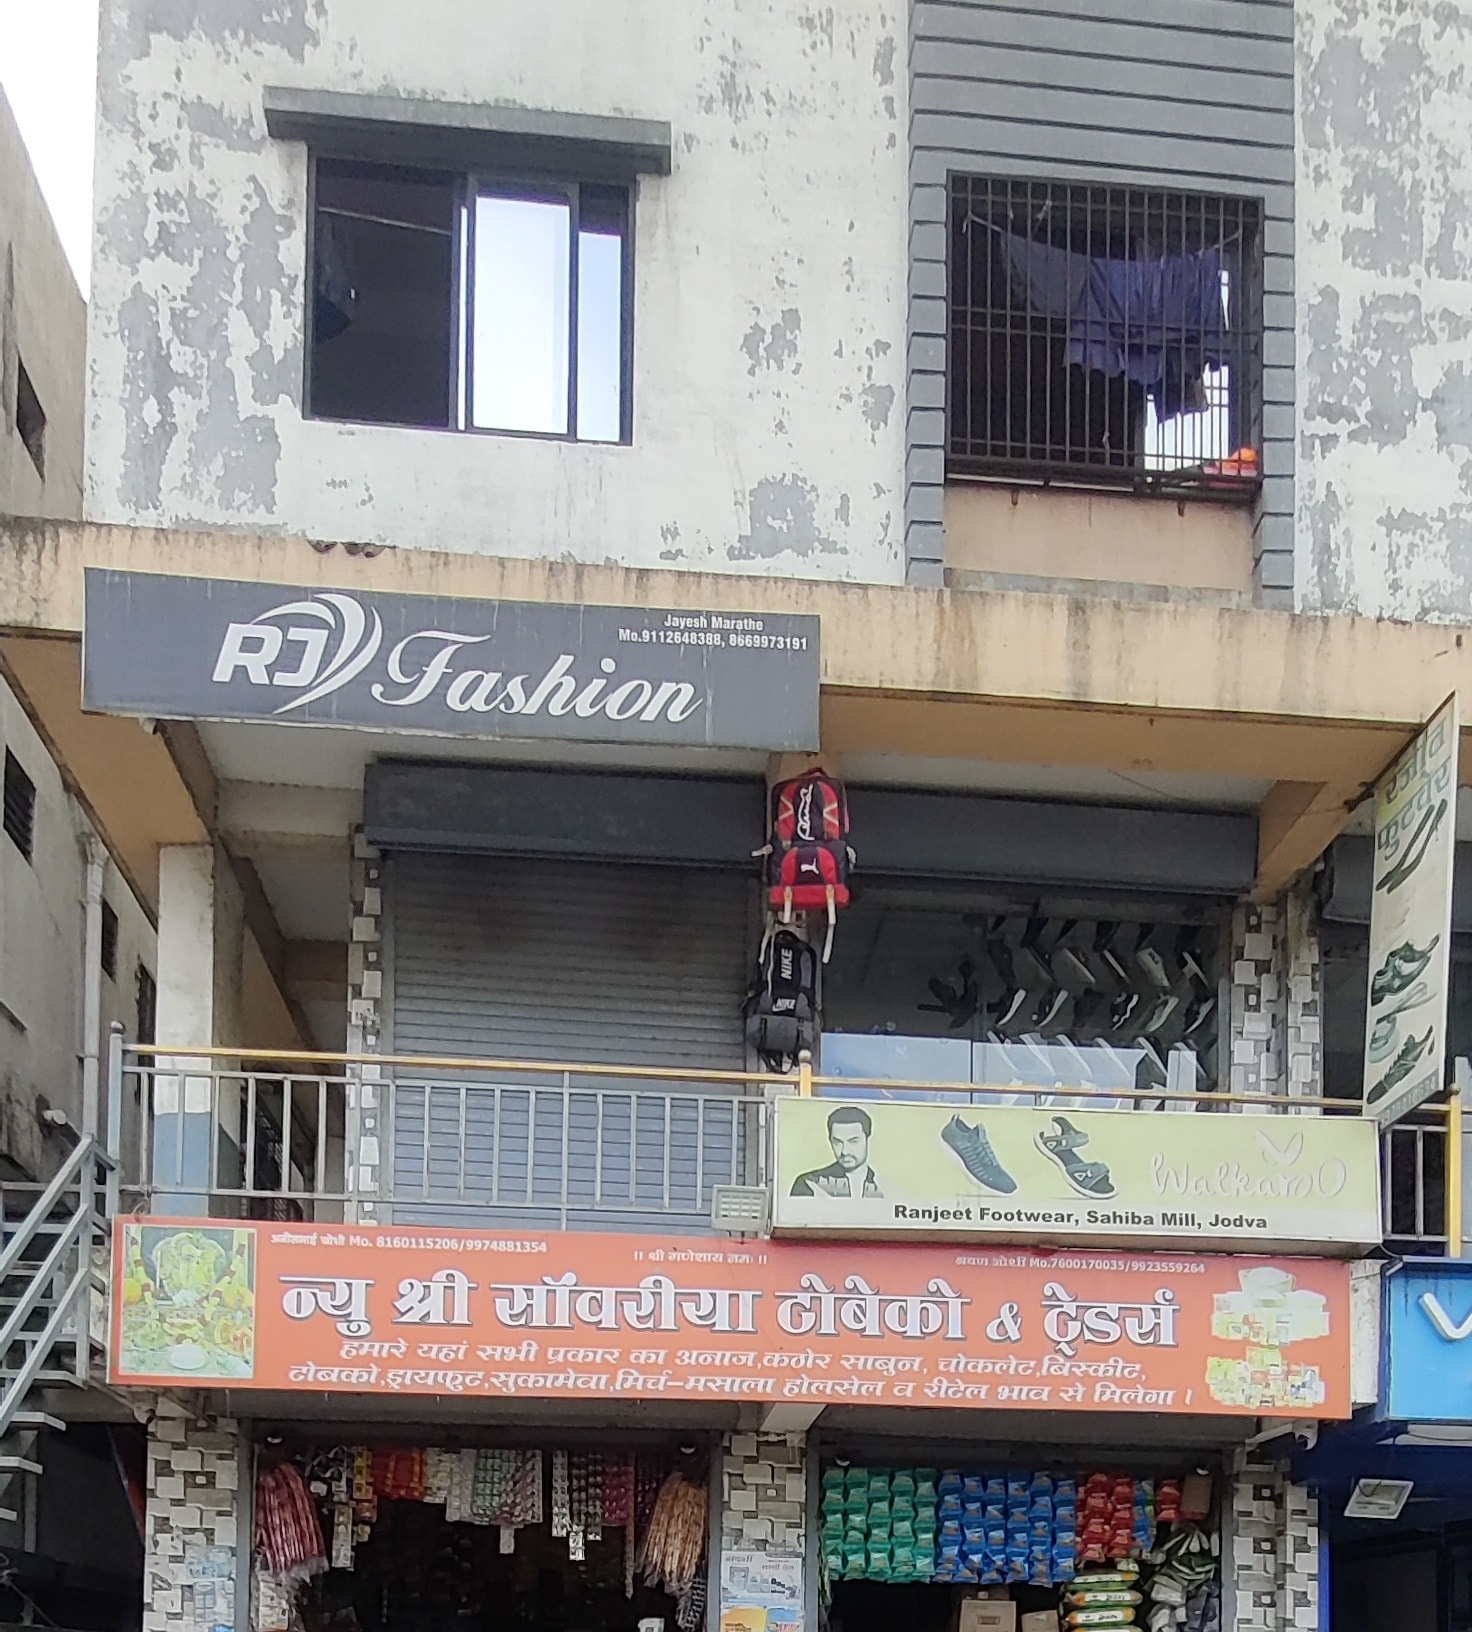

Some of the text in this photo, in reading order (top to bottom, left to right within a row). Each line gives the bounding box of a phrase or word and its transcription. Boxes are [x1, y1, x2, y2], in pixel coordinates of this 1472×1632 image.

[664, 614, 763, 630] Jayesh Marathe
[371, 630, 703, 722] Fashion
[781, 948, 793, 980] NIKE
[894, 1204, 1268, 1229] Ranjeet Footwear, Sahiba Mill, Jodva
[392, 1269, 478, 1325] श्री
[775, 1273, 971, 1340] टोबेको
[986, 1302, 1022, 1342] &
[1042, 1281, 1180, 1356] ट्रेडर्स
[339, 1338, 409, 1359] हमारे
[417, 1340, 469, 1361] यहां
[477, 1340, 539, 1362] सभी
[547, 1346, 622, 1365] प्रकार
[629, 1348, 668, 1365] का
[840, 1353, 928, 1376] साबुन,
[783, 1375, 885, 1397] होलसेल
[893, 1382, 916, 1398] व
[924, 1376, 990, 1399] रीटेल
[997, 1385, 1052, 1402] भाव
[1059, 1382, 1086, 1403] से
[1093, 1382, 1176, 1405] मिलेगा
